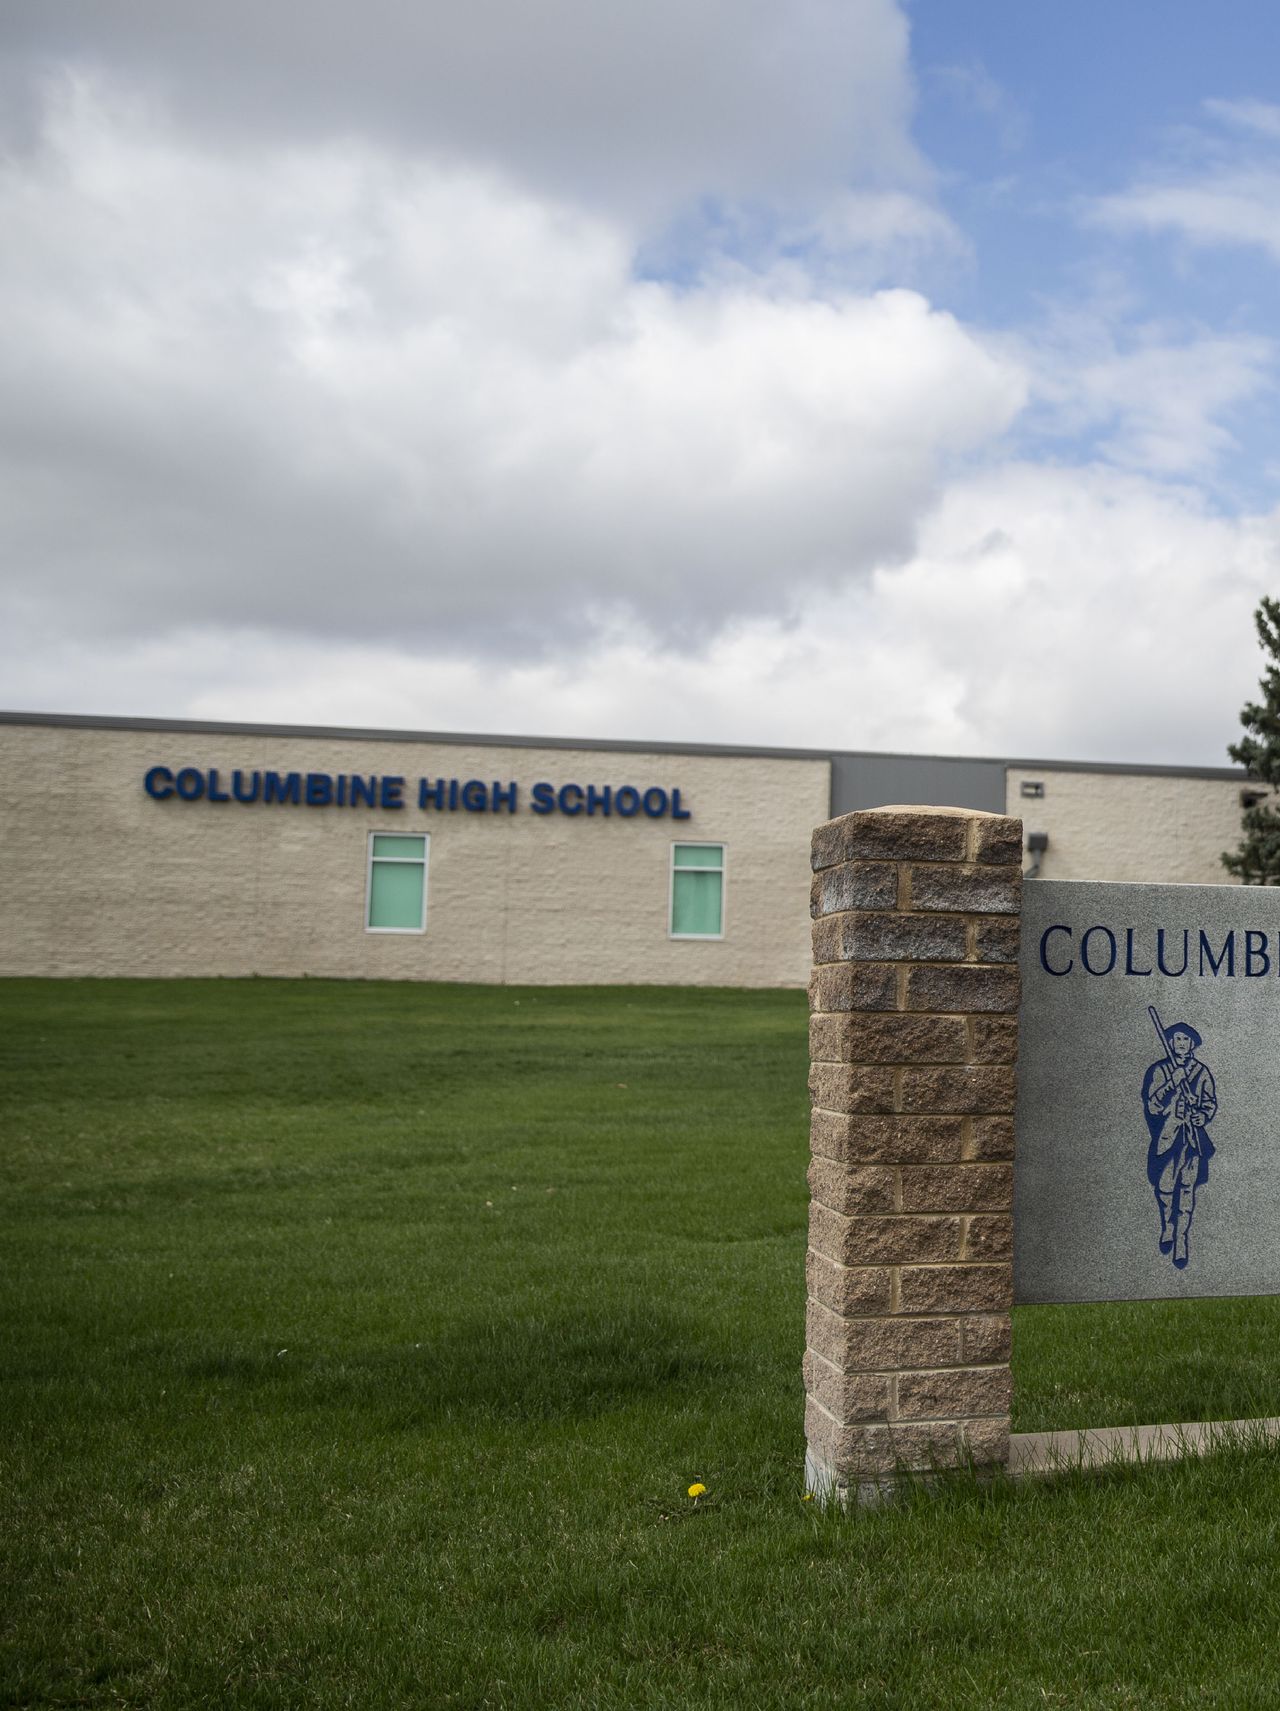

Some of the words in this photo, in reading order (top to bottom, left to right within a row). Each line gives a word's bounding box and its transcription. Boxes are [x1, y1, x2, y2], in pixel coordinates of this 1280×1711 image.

[143, 766, 404, 810] COLUMBINE
[418, 777, 517, 814] HIGH
[530, 783, 691, 819] SCHOOL
